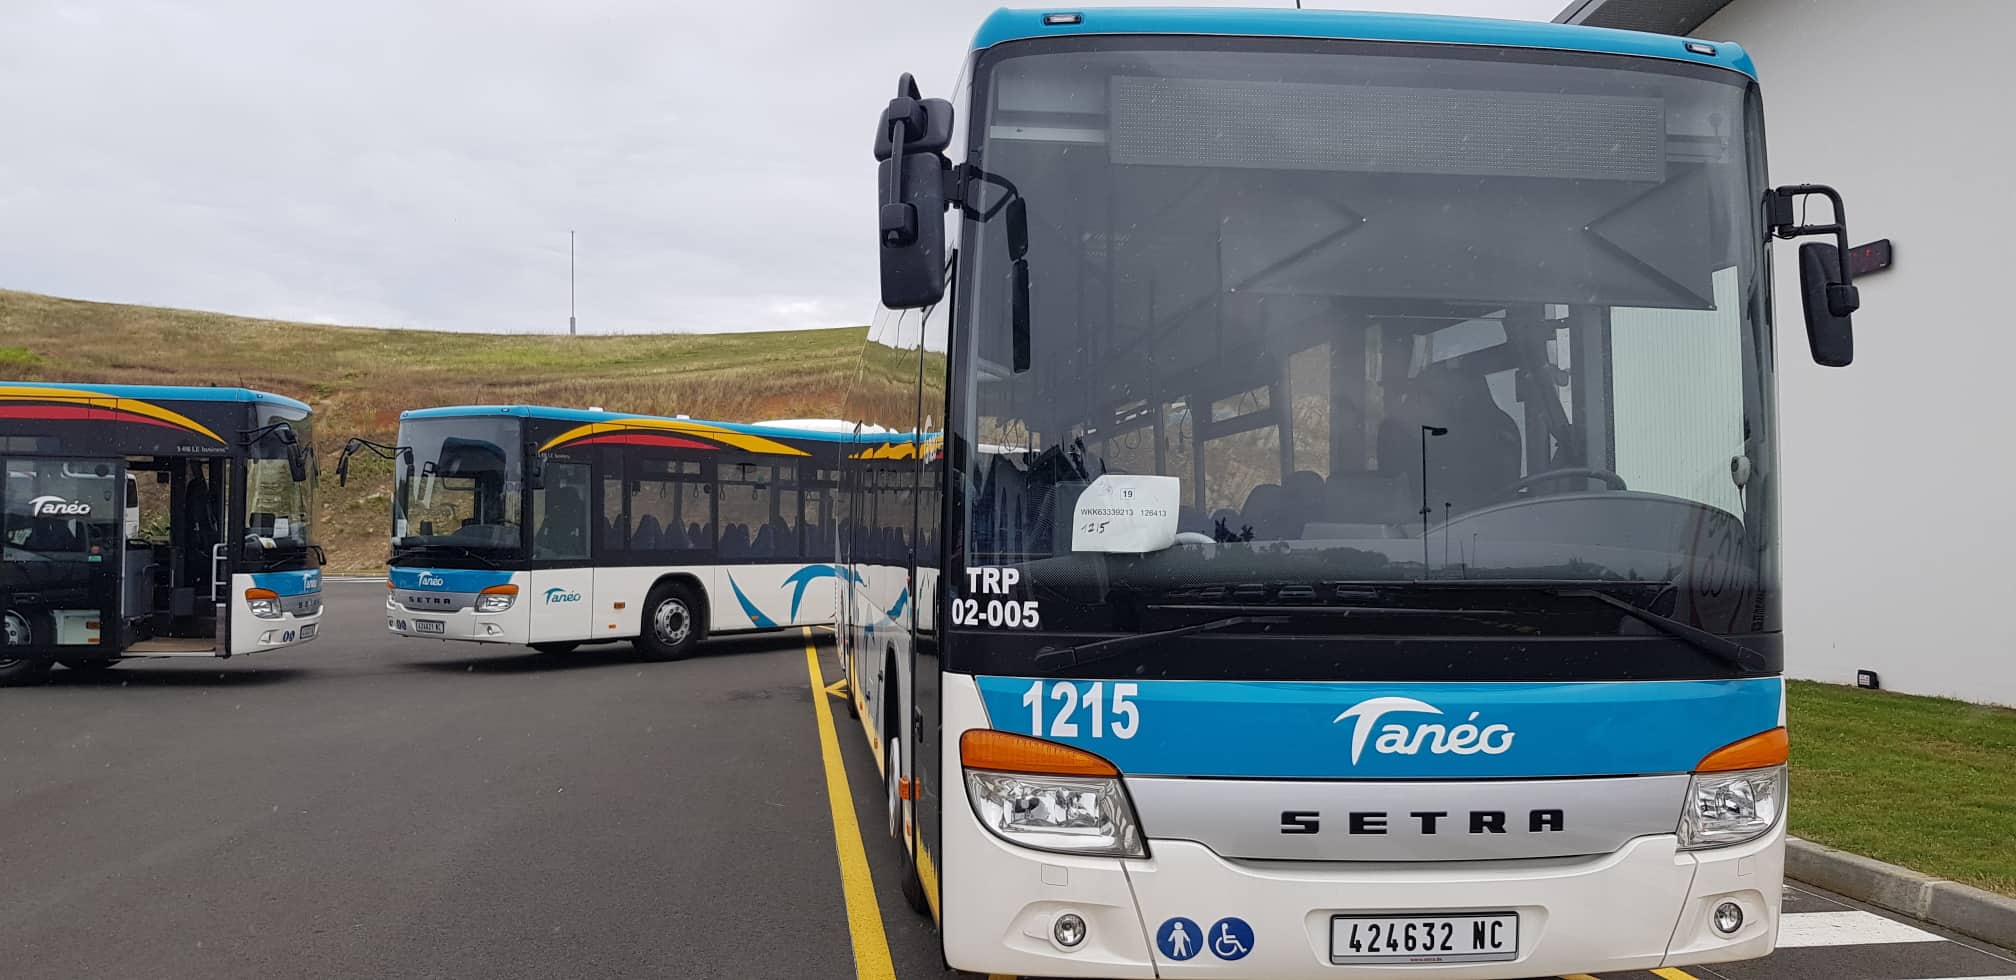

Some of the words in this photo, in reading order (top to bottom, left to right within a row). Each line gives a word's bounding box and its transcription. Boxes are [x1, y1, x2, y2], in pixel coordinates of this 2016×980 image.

[1122, 490, 1133, 498] 19
[28, 495, 91, 517] Tanéo
[1080, 508, 1134, 517] WKK63339213
[1140, 509, 1168, 517] 126413
[1081, 521, 1111, 534] 1215
[966, 567, 1020, 594] TRP
[408, 595, 451, 604] SETRA
[543, 587, 582, 606] Tanéo
[952, 598, 1040, 628] 02-005
[1023, 680, 1140, 740] 1215
[1332, 696, 1516, 767] Tanéo
[1280, 809, 1565, 834] SETRA
[1349, 922, 1454, 953] 424632
[1472, 920, 1504, 950] NC
